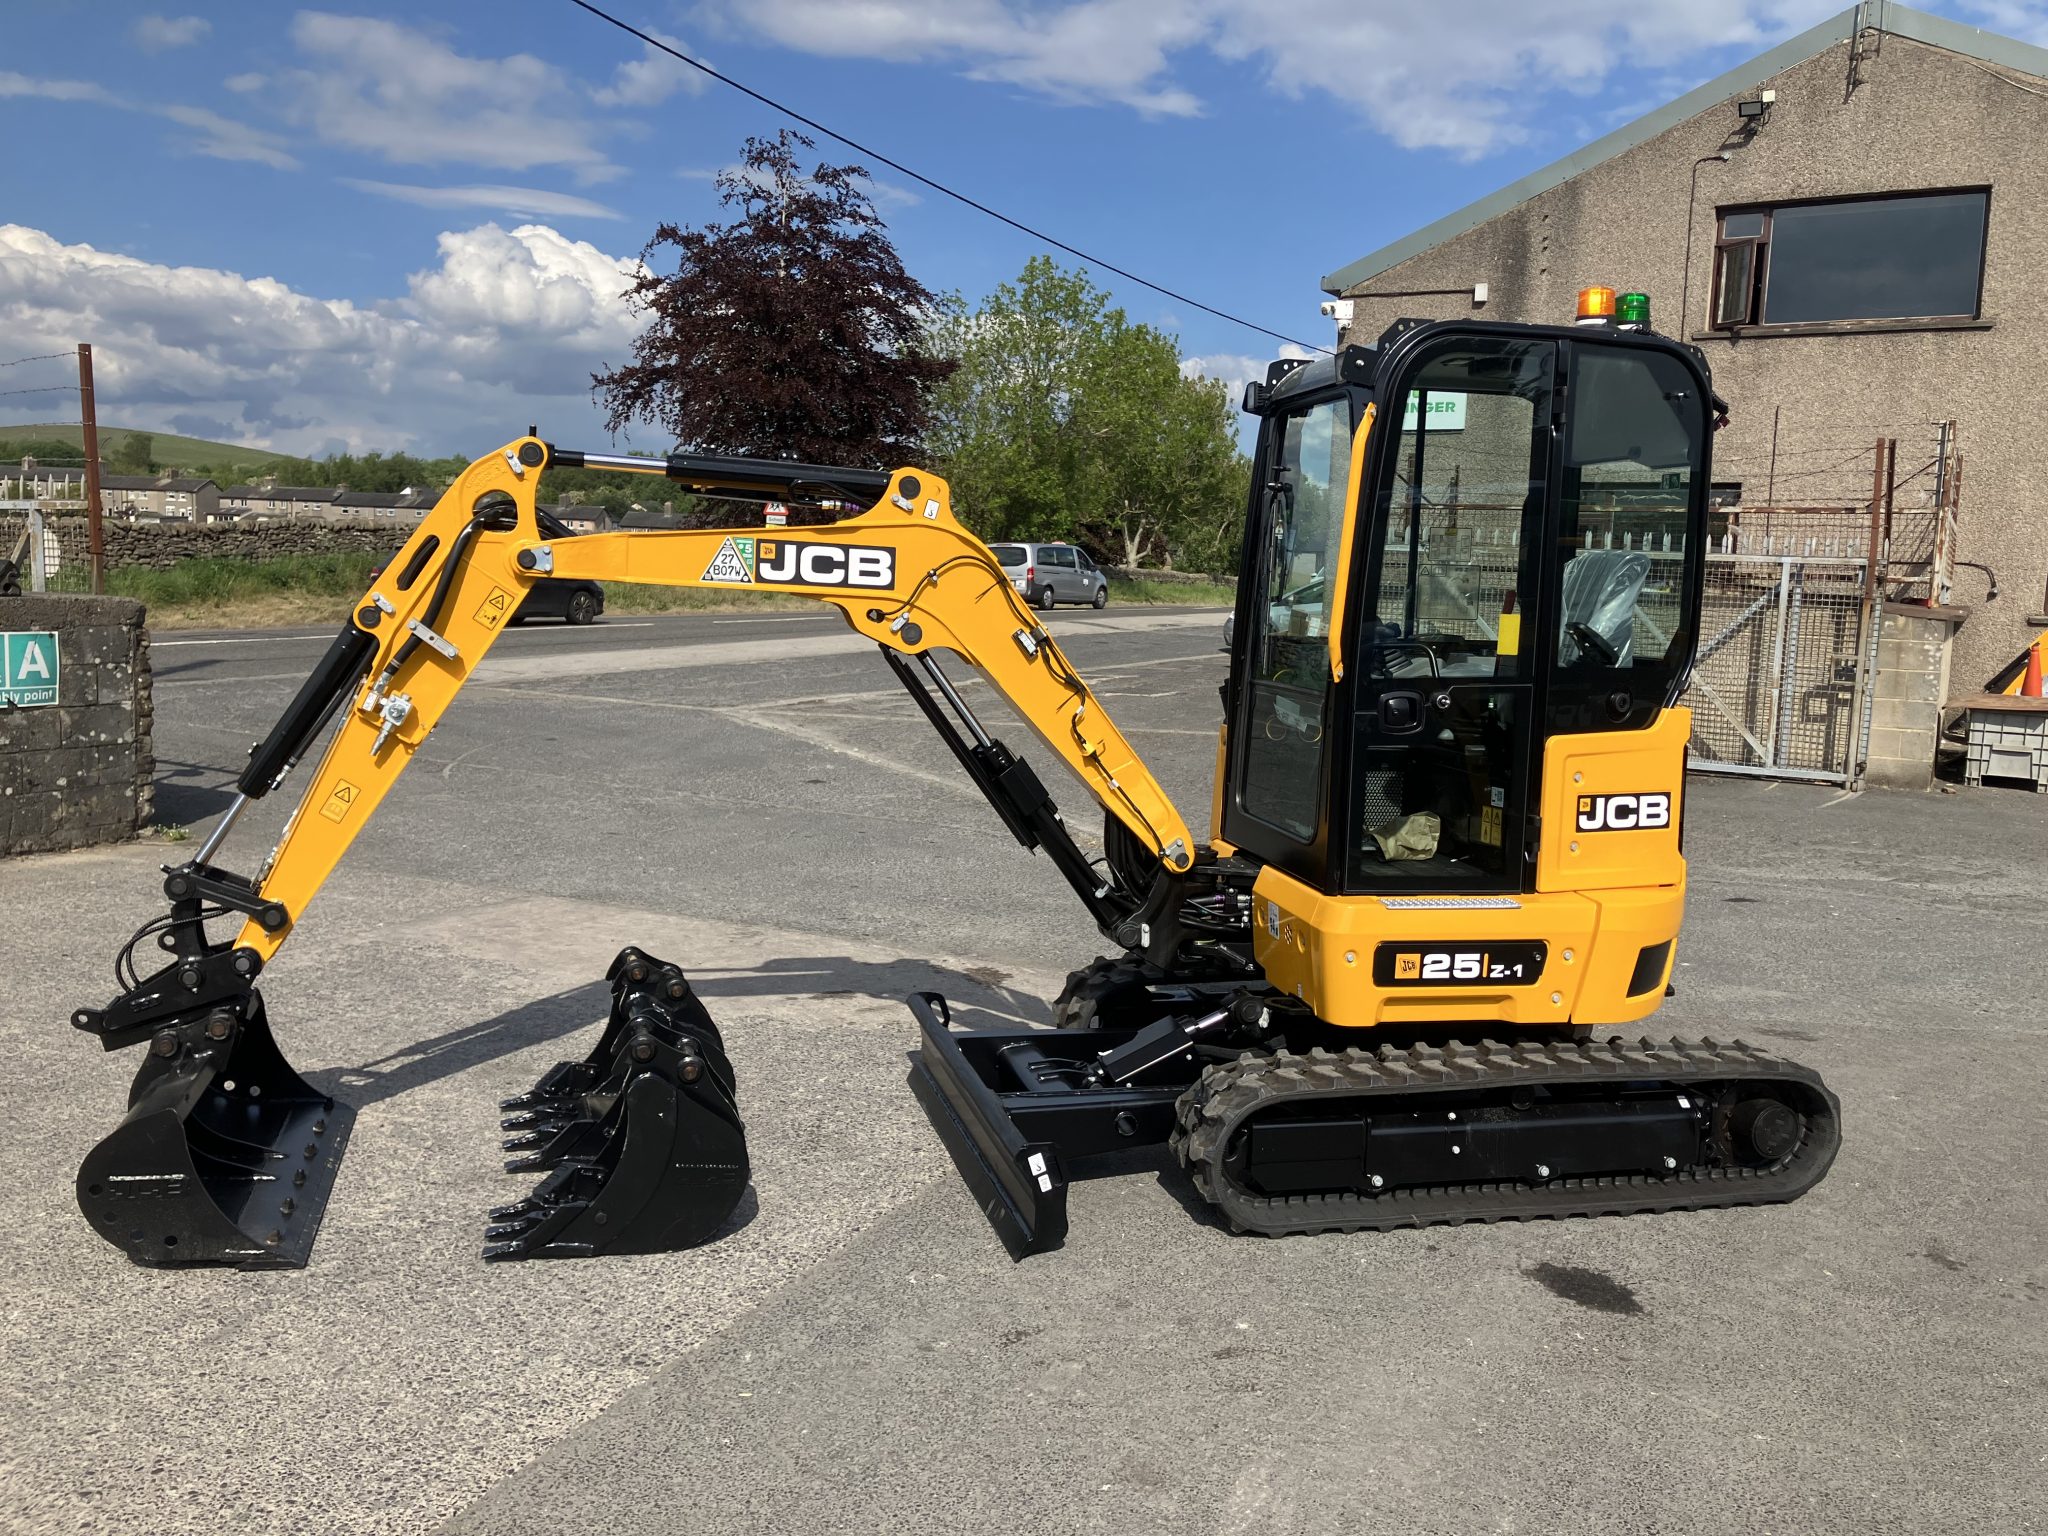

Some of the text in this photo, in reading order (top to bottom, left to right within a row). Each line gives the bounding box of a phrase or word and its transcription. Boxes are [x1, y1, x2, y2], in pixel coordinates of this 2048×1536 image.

[720, 553, 735, 564] 27
[759, 544, 893, 586] JCB
[17, 640, 50, 680] A
[0, 689, 53, 705] bly point
[1578, 795, 1669, 830] JCB
[1422, 953, 1481, 979] 25
